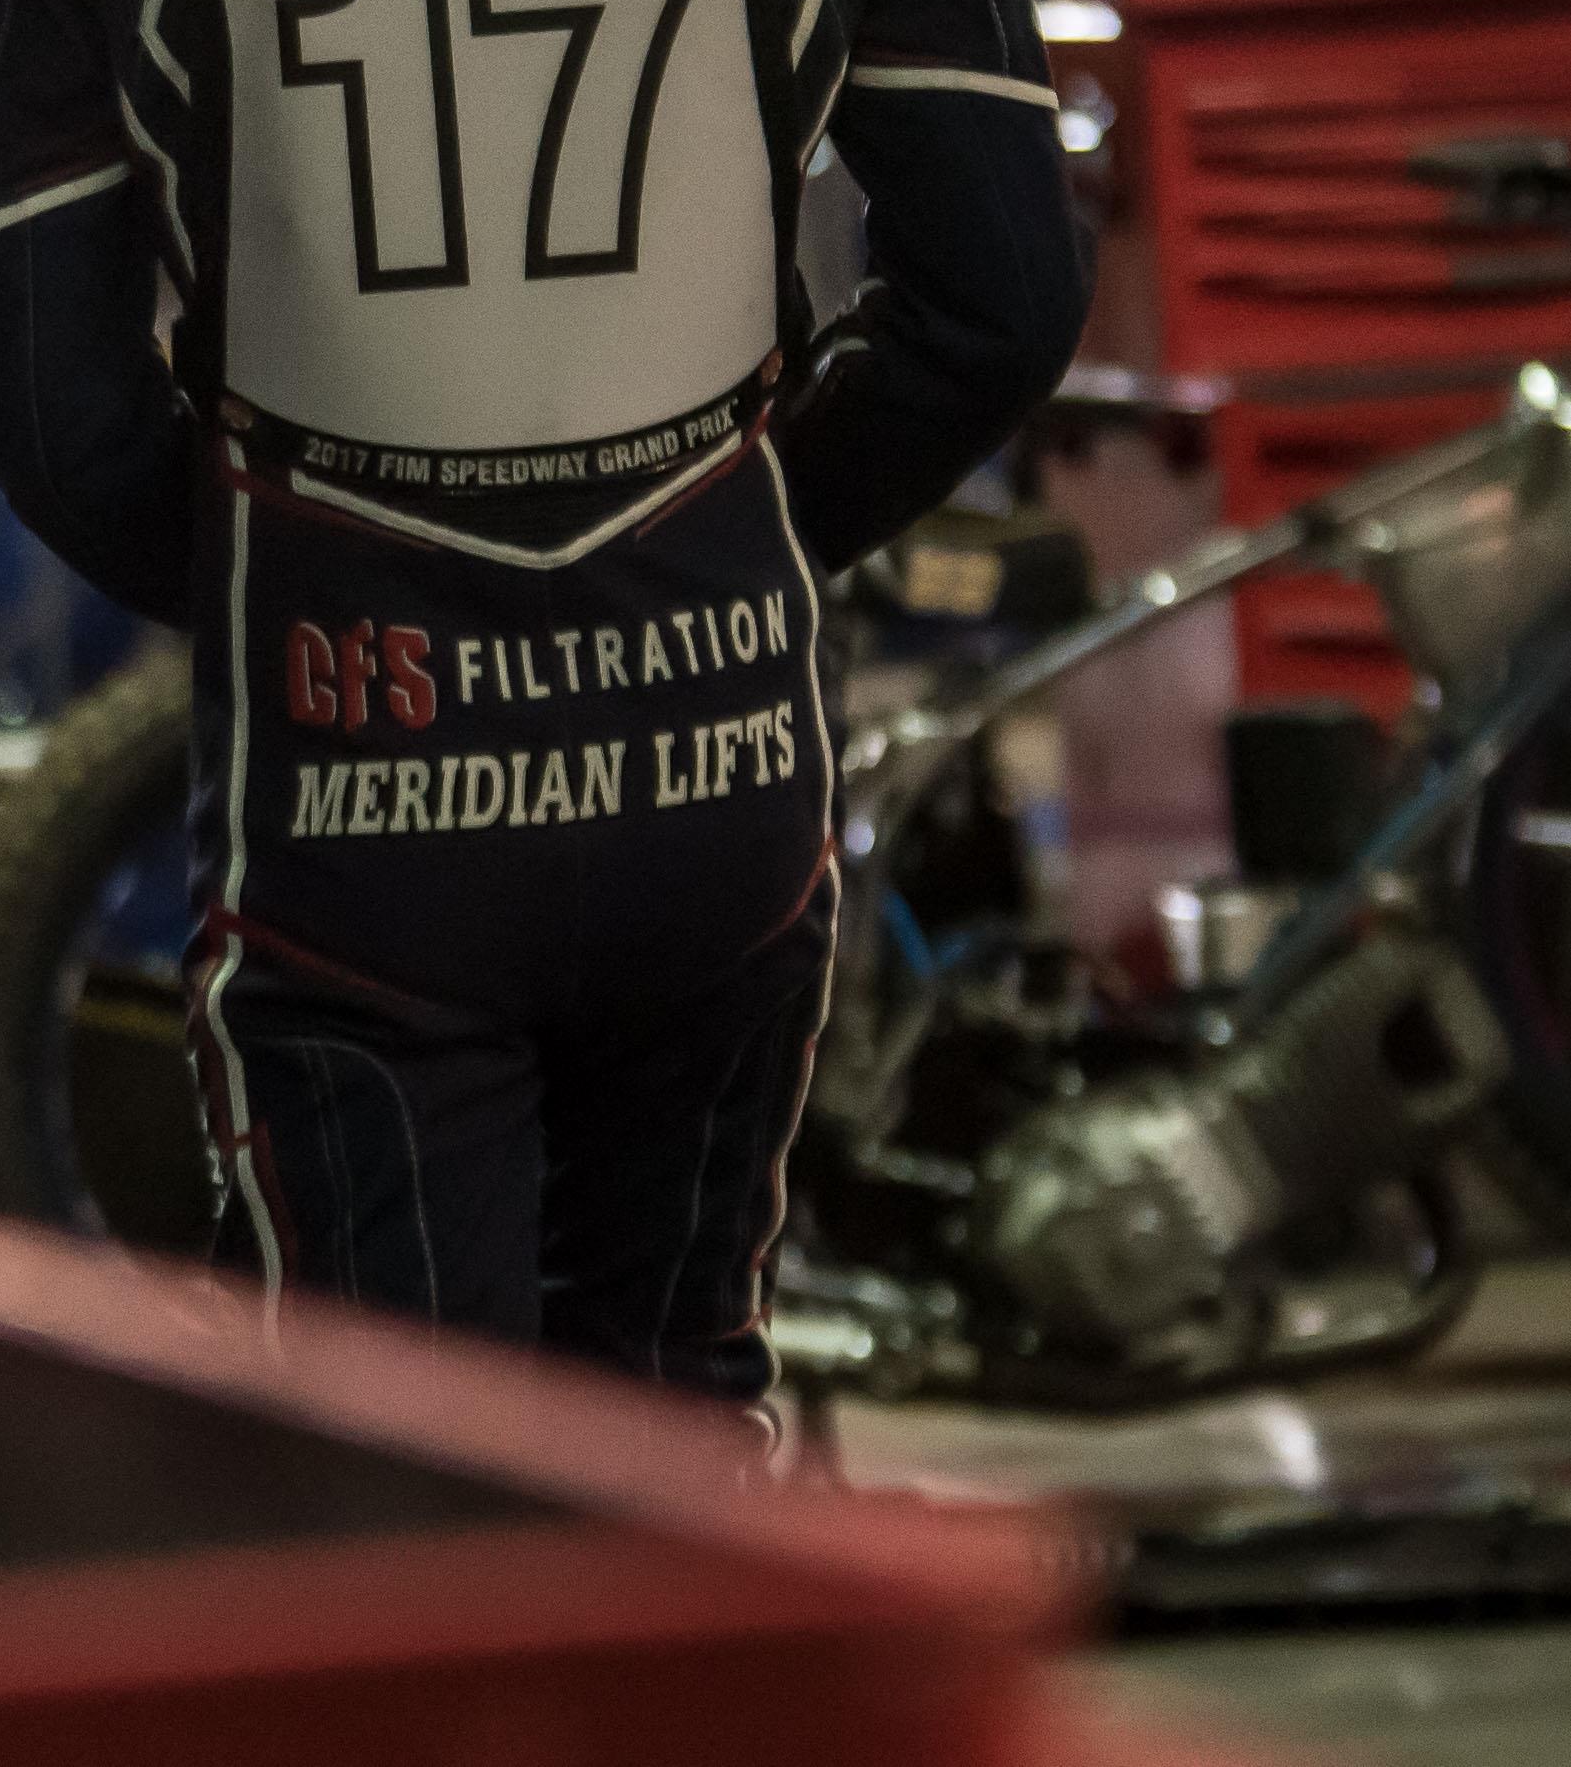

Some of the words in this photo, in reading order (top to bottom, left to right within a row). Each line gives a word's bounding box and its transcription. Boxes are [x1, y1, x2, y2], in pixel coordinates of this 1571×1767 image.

[303, 437, 370, 475] 2017
[378, 454, 431, 484] FIM
[439, 450, 588, 487] SPEEDWAY
[596, 430, 681, 475] GRAND
[457, 590, 789, 705] FILTRATION
[289, 741, 626, 838] MERIDIAN
[654, 699, 797, 810] LIFTS
